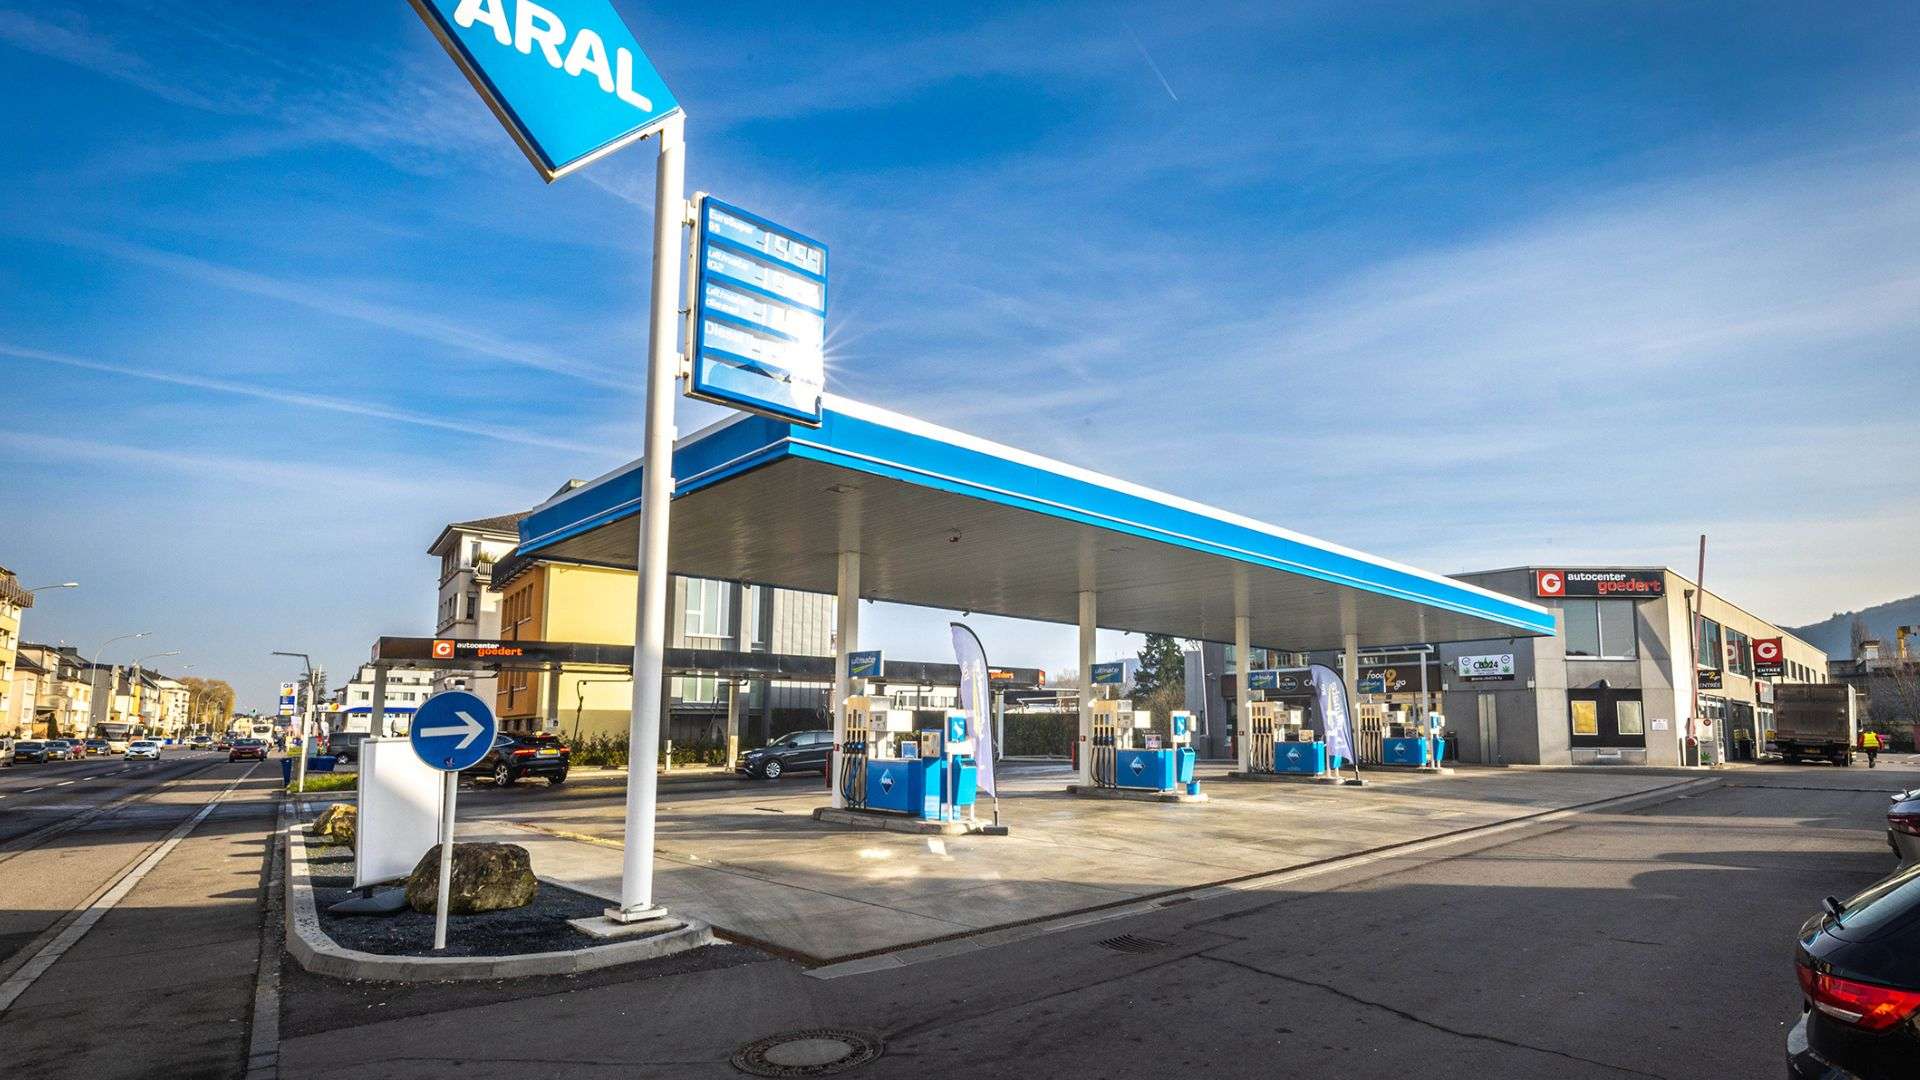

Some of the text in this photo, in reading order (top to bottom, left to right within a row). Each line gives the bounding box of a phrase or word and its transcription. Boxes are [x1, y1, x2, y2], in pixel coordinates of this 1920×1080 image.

[454, 0, 653, 112] ARAL
[1567, 573, 1626, 581] autocenter
[1597, 578, 1661, 594] goedert
[478, 646, 523, 656] goedert
